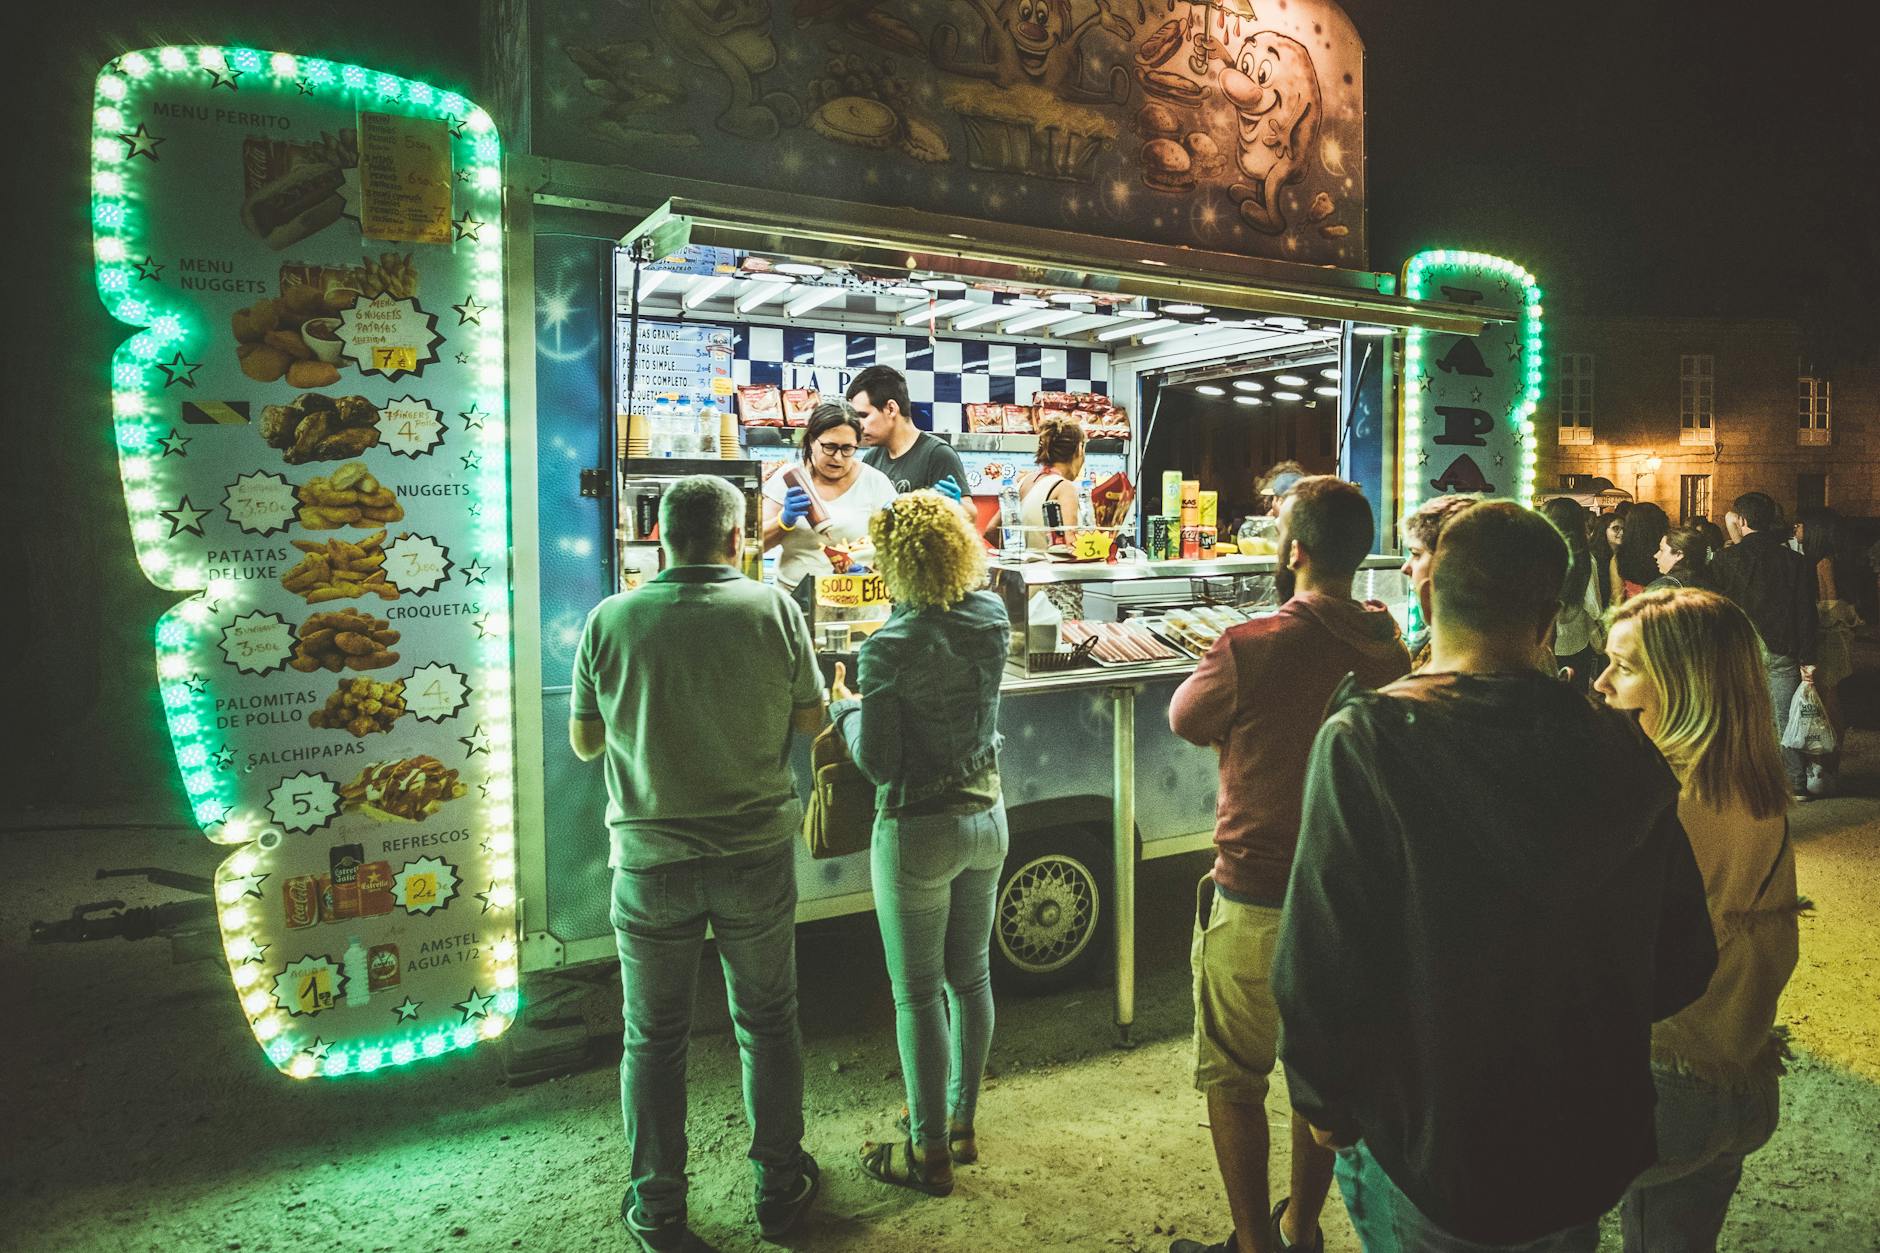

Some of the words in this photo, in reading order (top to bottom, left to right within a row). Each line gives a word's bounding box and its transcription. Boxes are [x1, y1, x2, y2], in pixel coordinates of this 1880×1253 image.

[153, 102, 209, 121] MENU
[215, 108, 291, 130] PERRITO
[180, 258, 234, 274] MENU
[180, 277, 267, 293] NUGGETS
[652, 329, 680, 341] GRANDE
[652, 345, 670, 356] LUXE
[622, 359, 651, 371] PERITO
[652, 360, 676, 372] SIMPLE
[652, 375, 689, 388] COMPLETO
[396, 483, 470, 498] NUGGETS
[207, 548, 288, 564] PATATAS
[208, 566, 280, 581] DELUXE
[822, 578, 853, 594] SOLO
[386, 602, 481, 620] CROQUETAS
[215, 690, 318, 712] PALOMITAS
[216, 714, 241, 729] DE
[246, 709, 303, 728] POLLO
[248, 741, 366, 766] SALCHIPAPAS
[382, 828, 470, 853] REFRESCOS
[420, 931, 480, 954] AMSTEL
[407, 953, 452, 972] AGUA
[456, 947, 480, 963] 1/2
